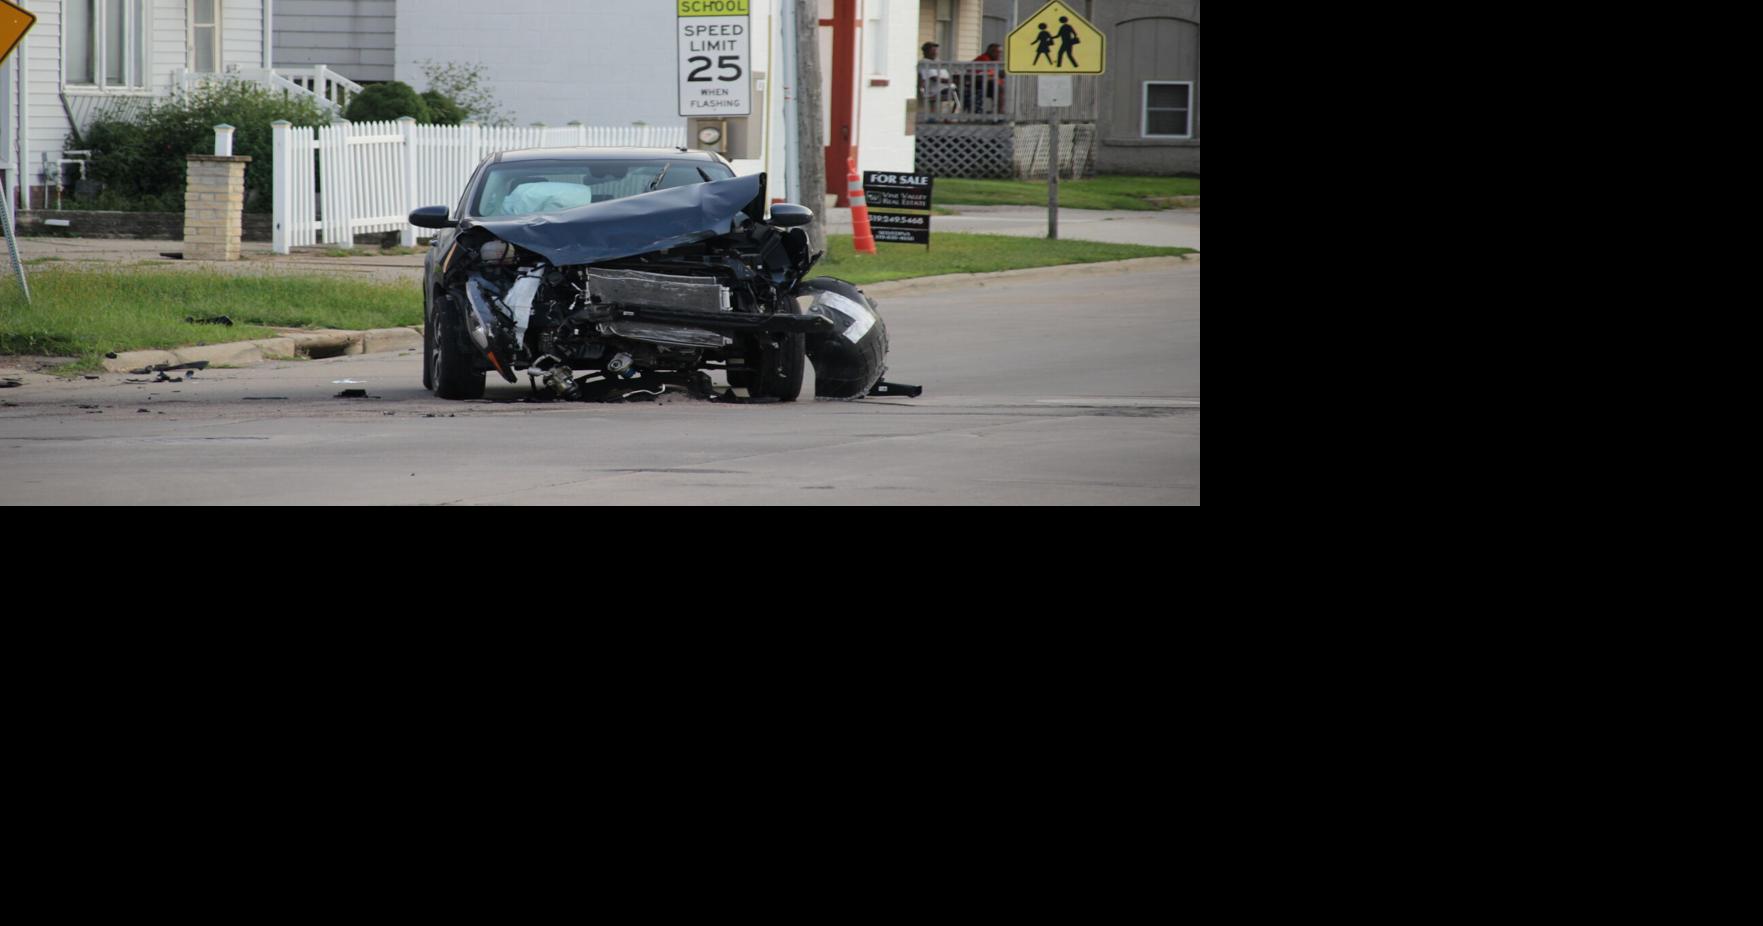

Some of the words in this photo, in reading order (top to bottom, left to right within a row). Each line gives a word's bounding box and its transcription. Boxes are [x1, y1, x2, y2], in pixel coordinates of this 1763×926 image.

[681, 0, 746, 12] SCHOOL
[684, 24, 744, 37] SPEED
[690, 40, 737, 52] LIMIT
[687, 55, 742, 82] 25
[690, 99, 740, 108] FLASHING
[870, 174, 897, 184] FOR
[899, 175, 929, 186] SALE
